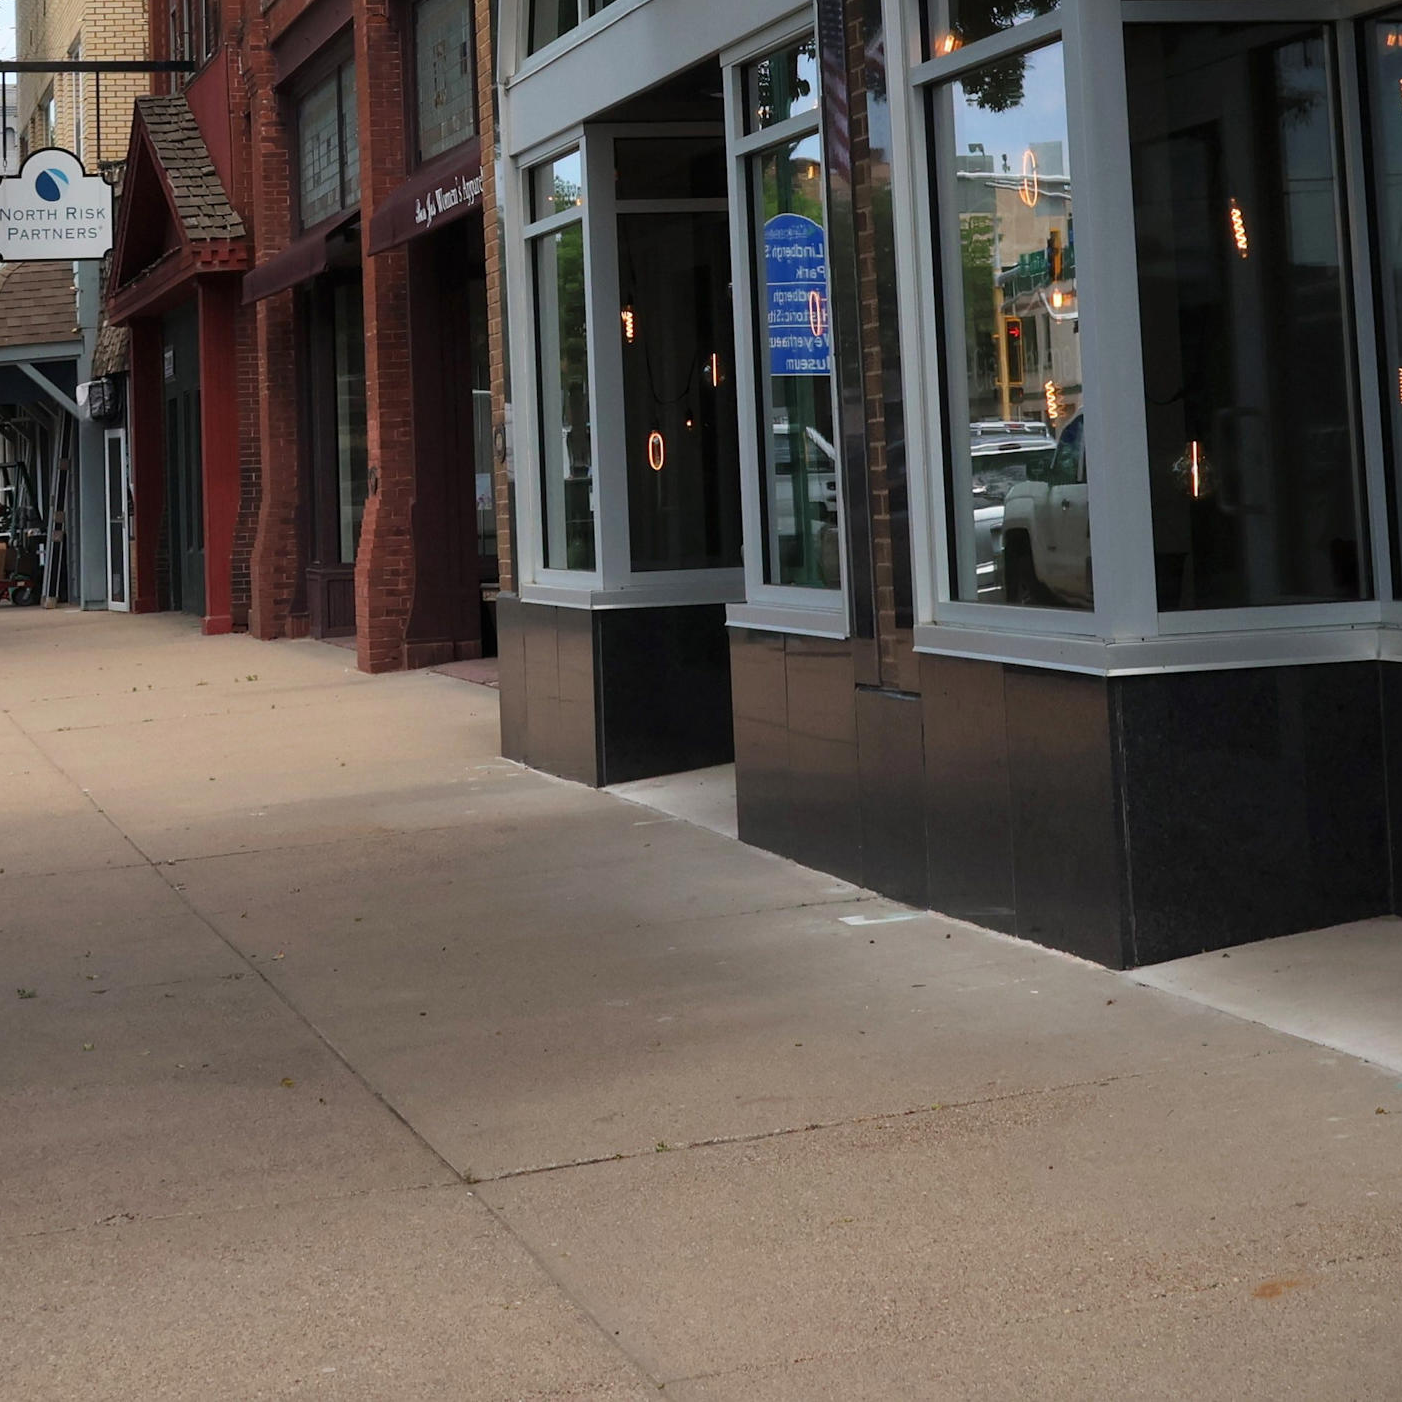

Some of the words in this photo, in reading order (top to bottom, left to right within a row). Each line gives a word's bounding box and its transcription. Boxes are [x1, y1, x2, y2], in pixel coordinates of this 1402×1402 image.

[0, 208, 57, 221] NORTH
[66, 206, 106, 219] RISK
[8, 227, 98, 240] PARTNERS
